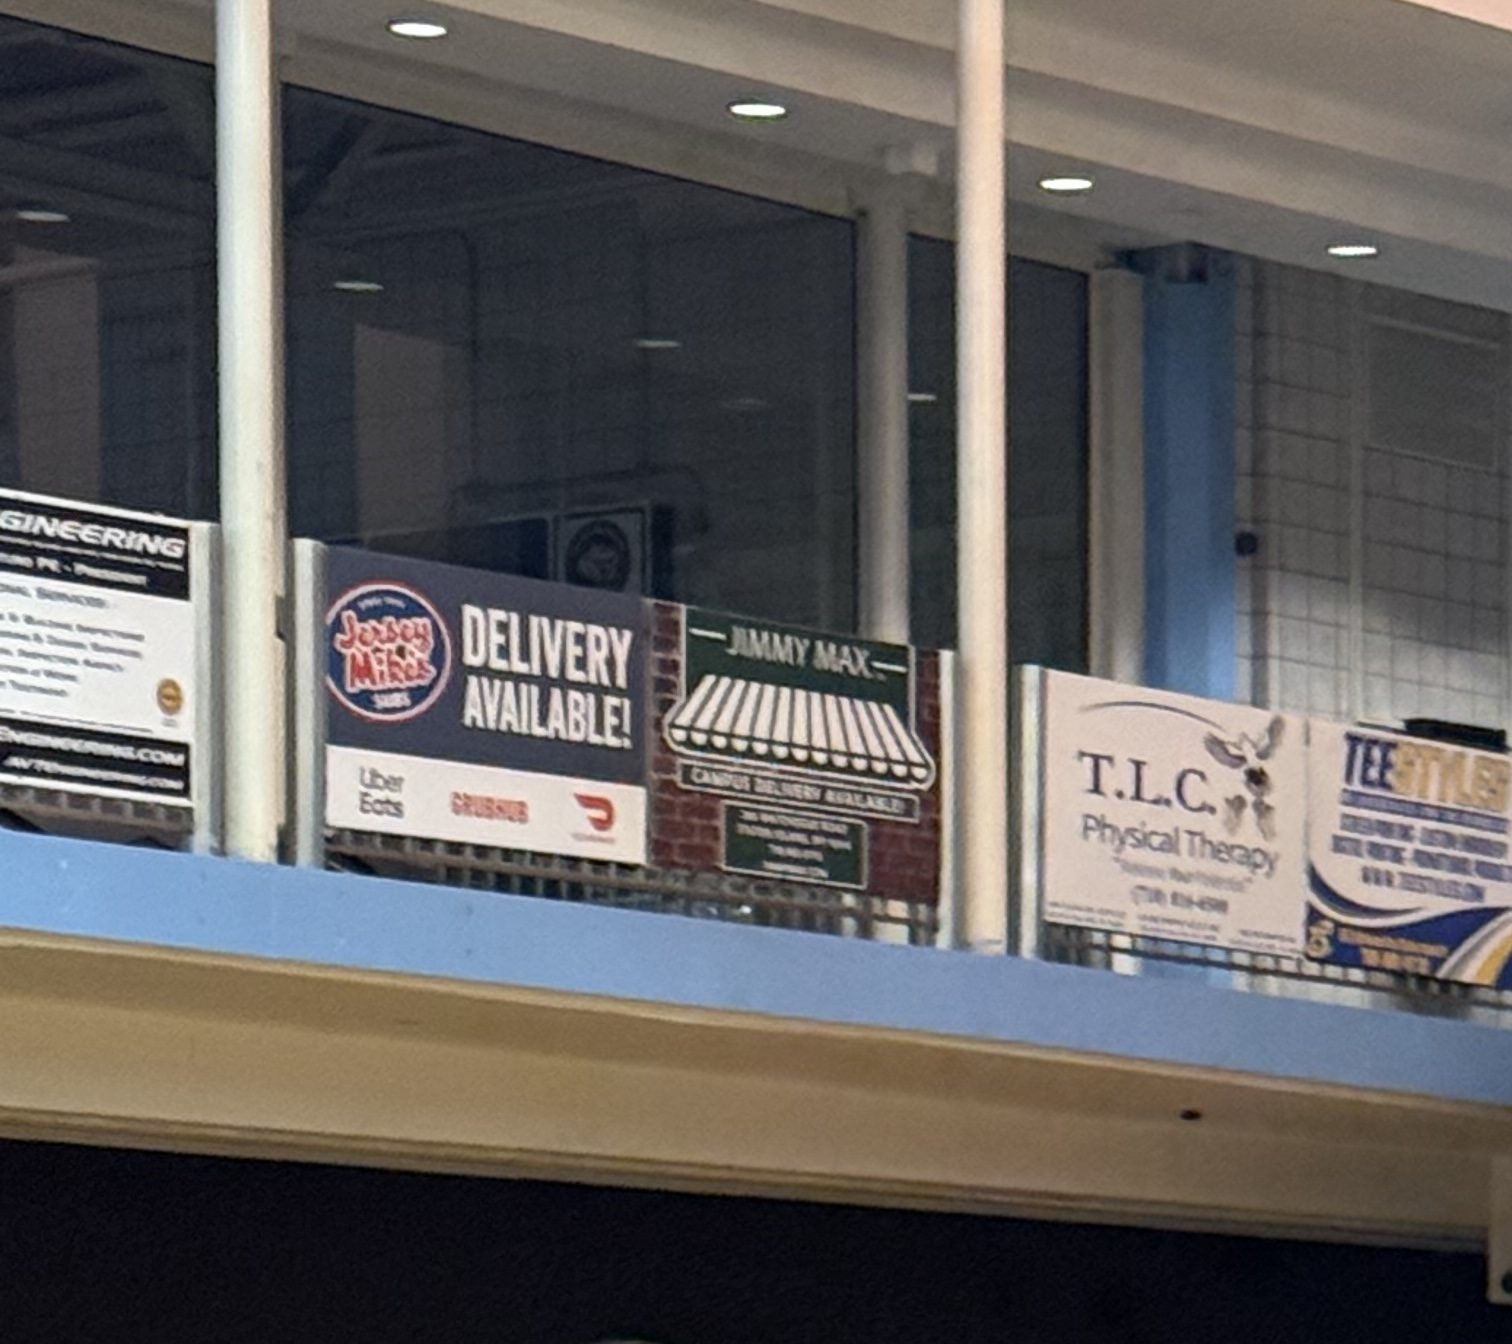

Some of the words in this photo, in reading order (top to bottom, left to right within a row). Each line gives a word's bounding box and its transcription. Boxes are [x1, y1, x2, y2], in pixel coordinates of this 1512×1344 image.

[334, 609, 434, 652] Jersey
[460, 603, 633, 690] DELIVERY
[725, 625, 811, 669] JIMMY
[812, 639, 873, 680] MAX
[461, 674, 634, 750] AVAILABLE!
[1077, 750, 1217, 816] T.L.C.
[1081, 813, 1181, 855] Physical
[1184, 829, 1280, 878] Therapy
